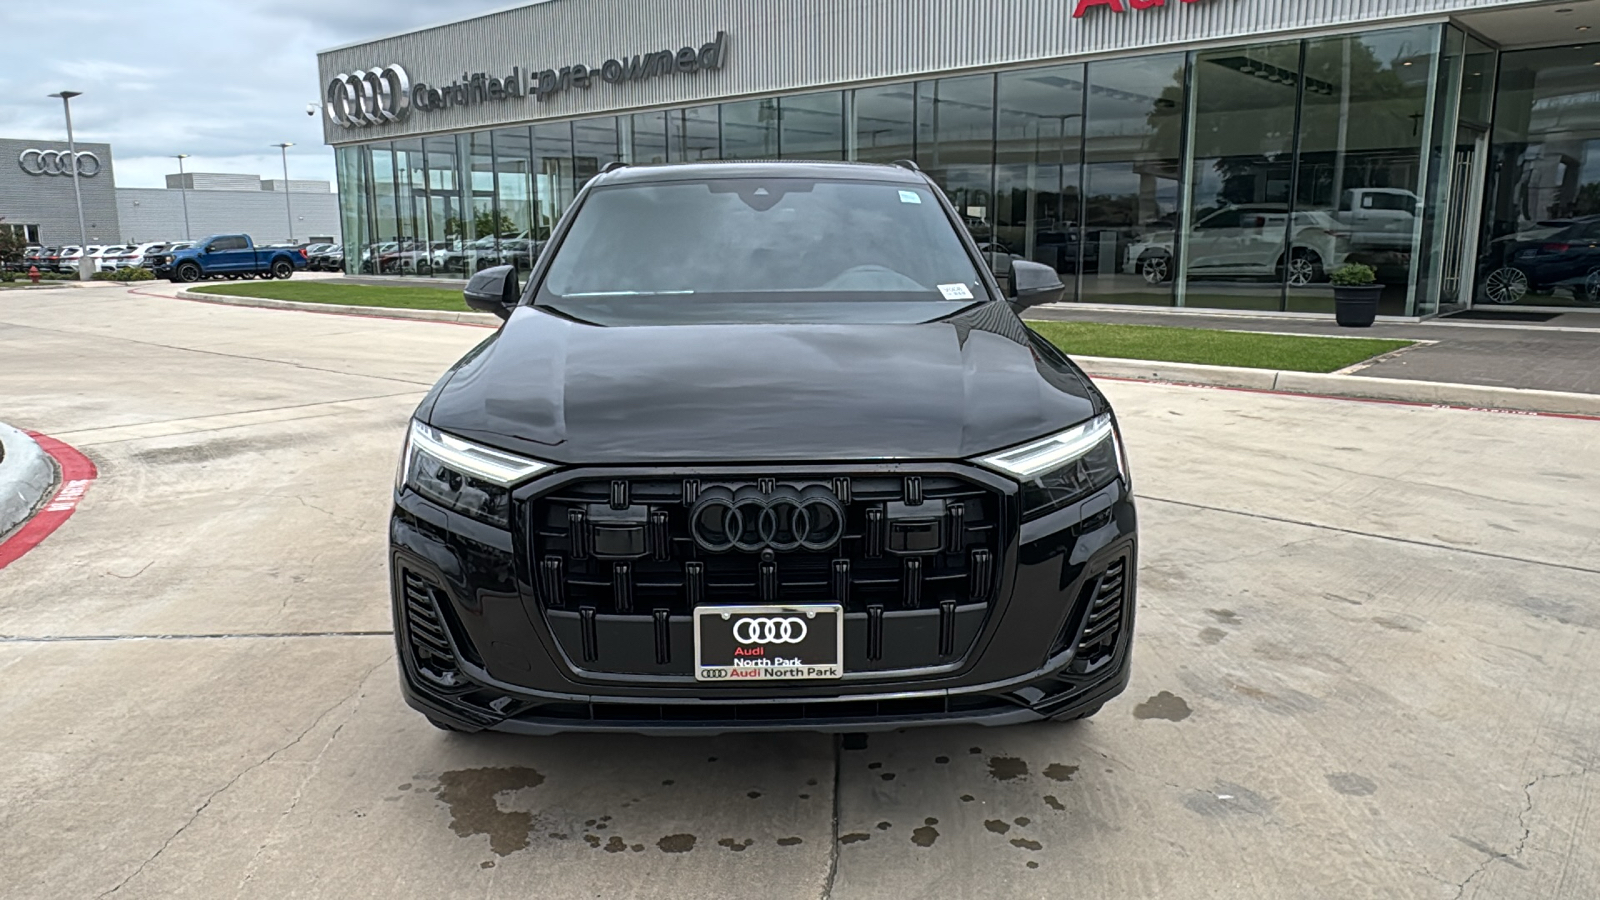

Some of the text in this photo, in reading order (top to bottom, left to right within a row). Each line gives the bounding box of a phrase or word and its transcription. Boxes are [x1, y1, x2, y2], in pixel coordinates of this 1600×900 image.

[412, 65, 523, 112] Certified
[734, 646, 764, 656] Audi
[733, 657, 802, 667] North Park
[729, 667, 837, 678] Audi North Park
